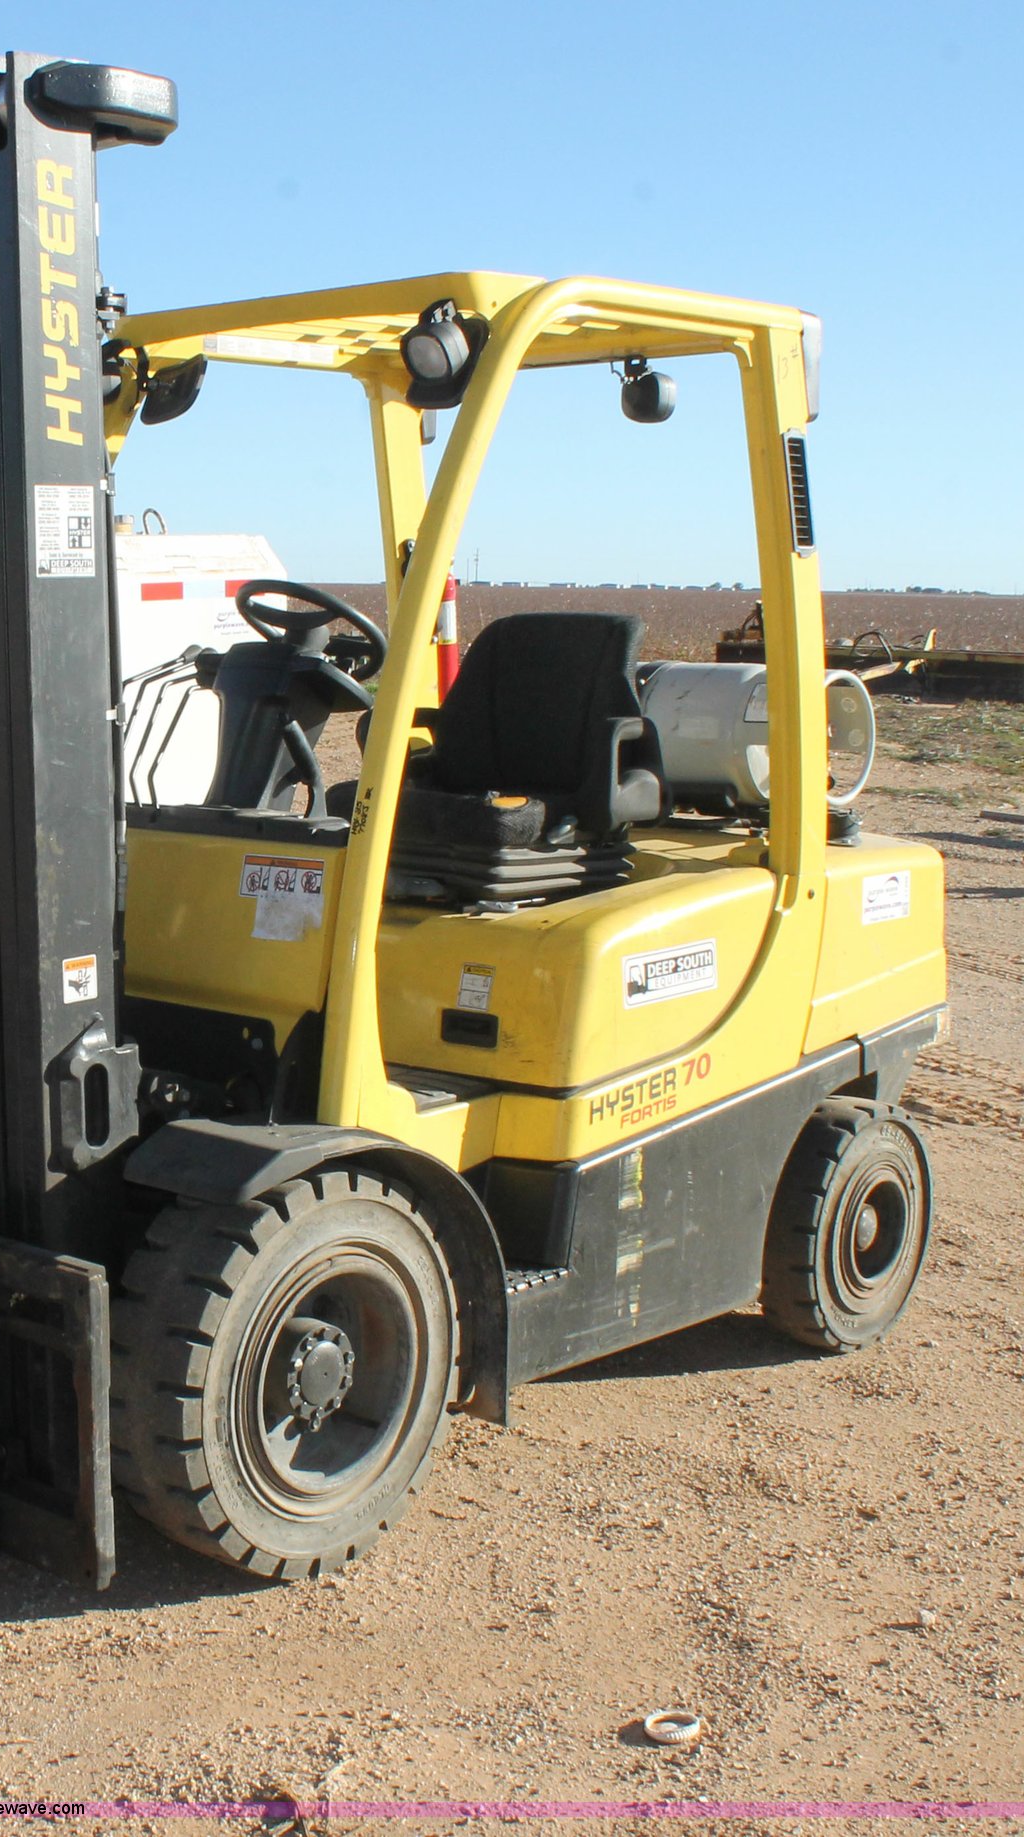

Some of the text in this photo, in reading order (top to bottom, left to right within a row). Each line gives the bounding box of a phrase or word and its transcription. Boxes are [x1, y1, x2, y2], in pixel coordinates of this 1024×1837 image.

[36, 158, 84, 447] HYSTER
[51, 560, 92, 568] DEEP SOUTH
[648, 951, 712, 978] DEEP SOUTH
[654, 967, 706, 988] EQUIPMENT
[589, 1053, 711, 1125] HYSTER 70
[620, 1094, 677, 1129] FORTIS
